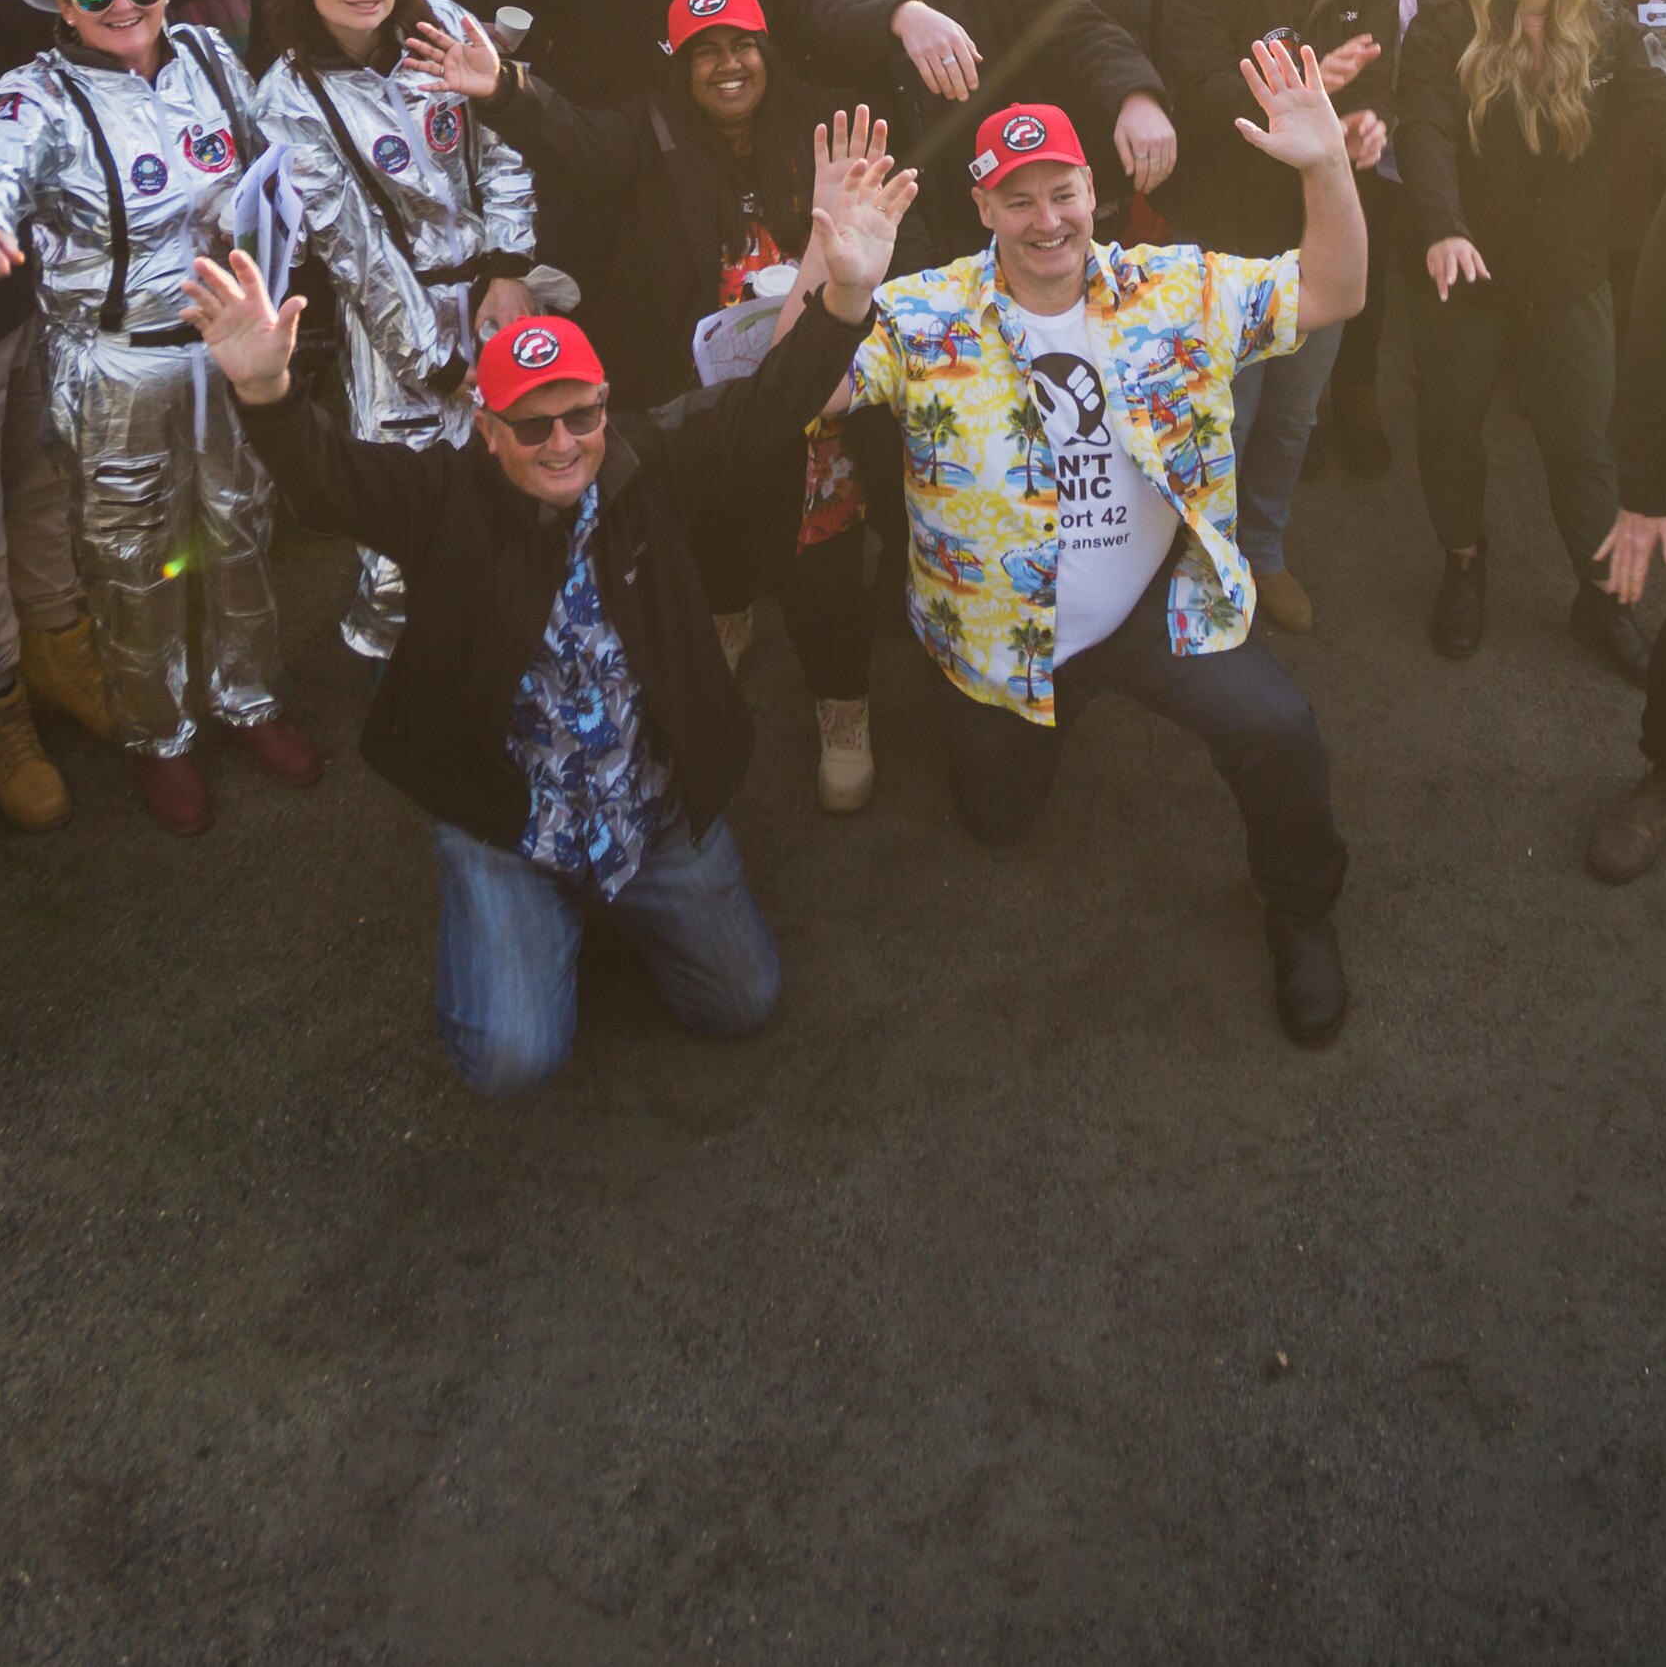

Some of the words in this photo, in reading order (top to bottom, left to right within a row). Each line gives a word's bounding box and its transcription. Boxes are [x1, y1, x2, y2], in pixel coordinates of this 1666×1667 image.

[1058, 452, 1113, 479] N'T
[1056, 476, 1113, 502] NIC
[1060, 508, 1094, 529] ort
[1101, 506, 1128, 526] 42
[1072, 533, 1131, 551] answer
